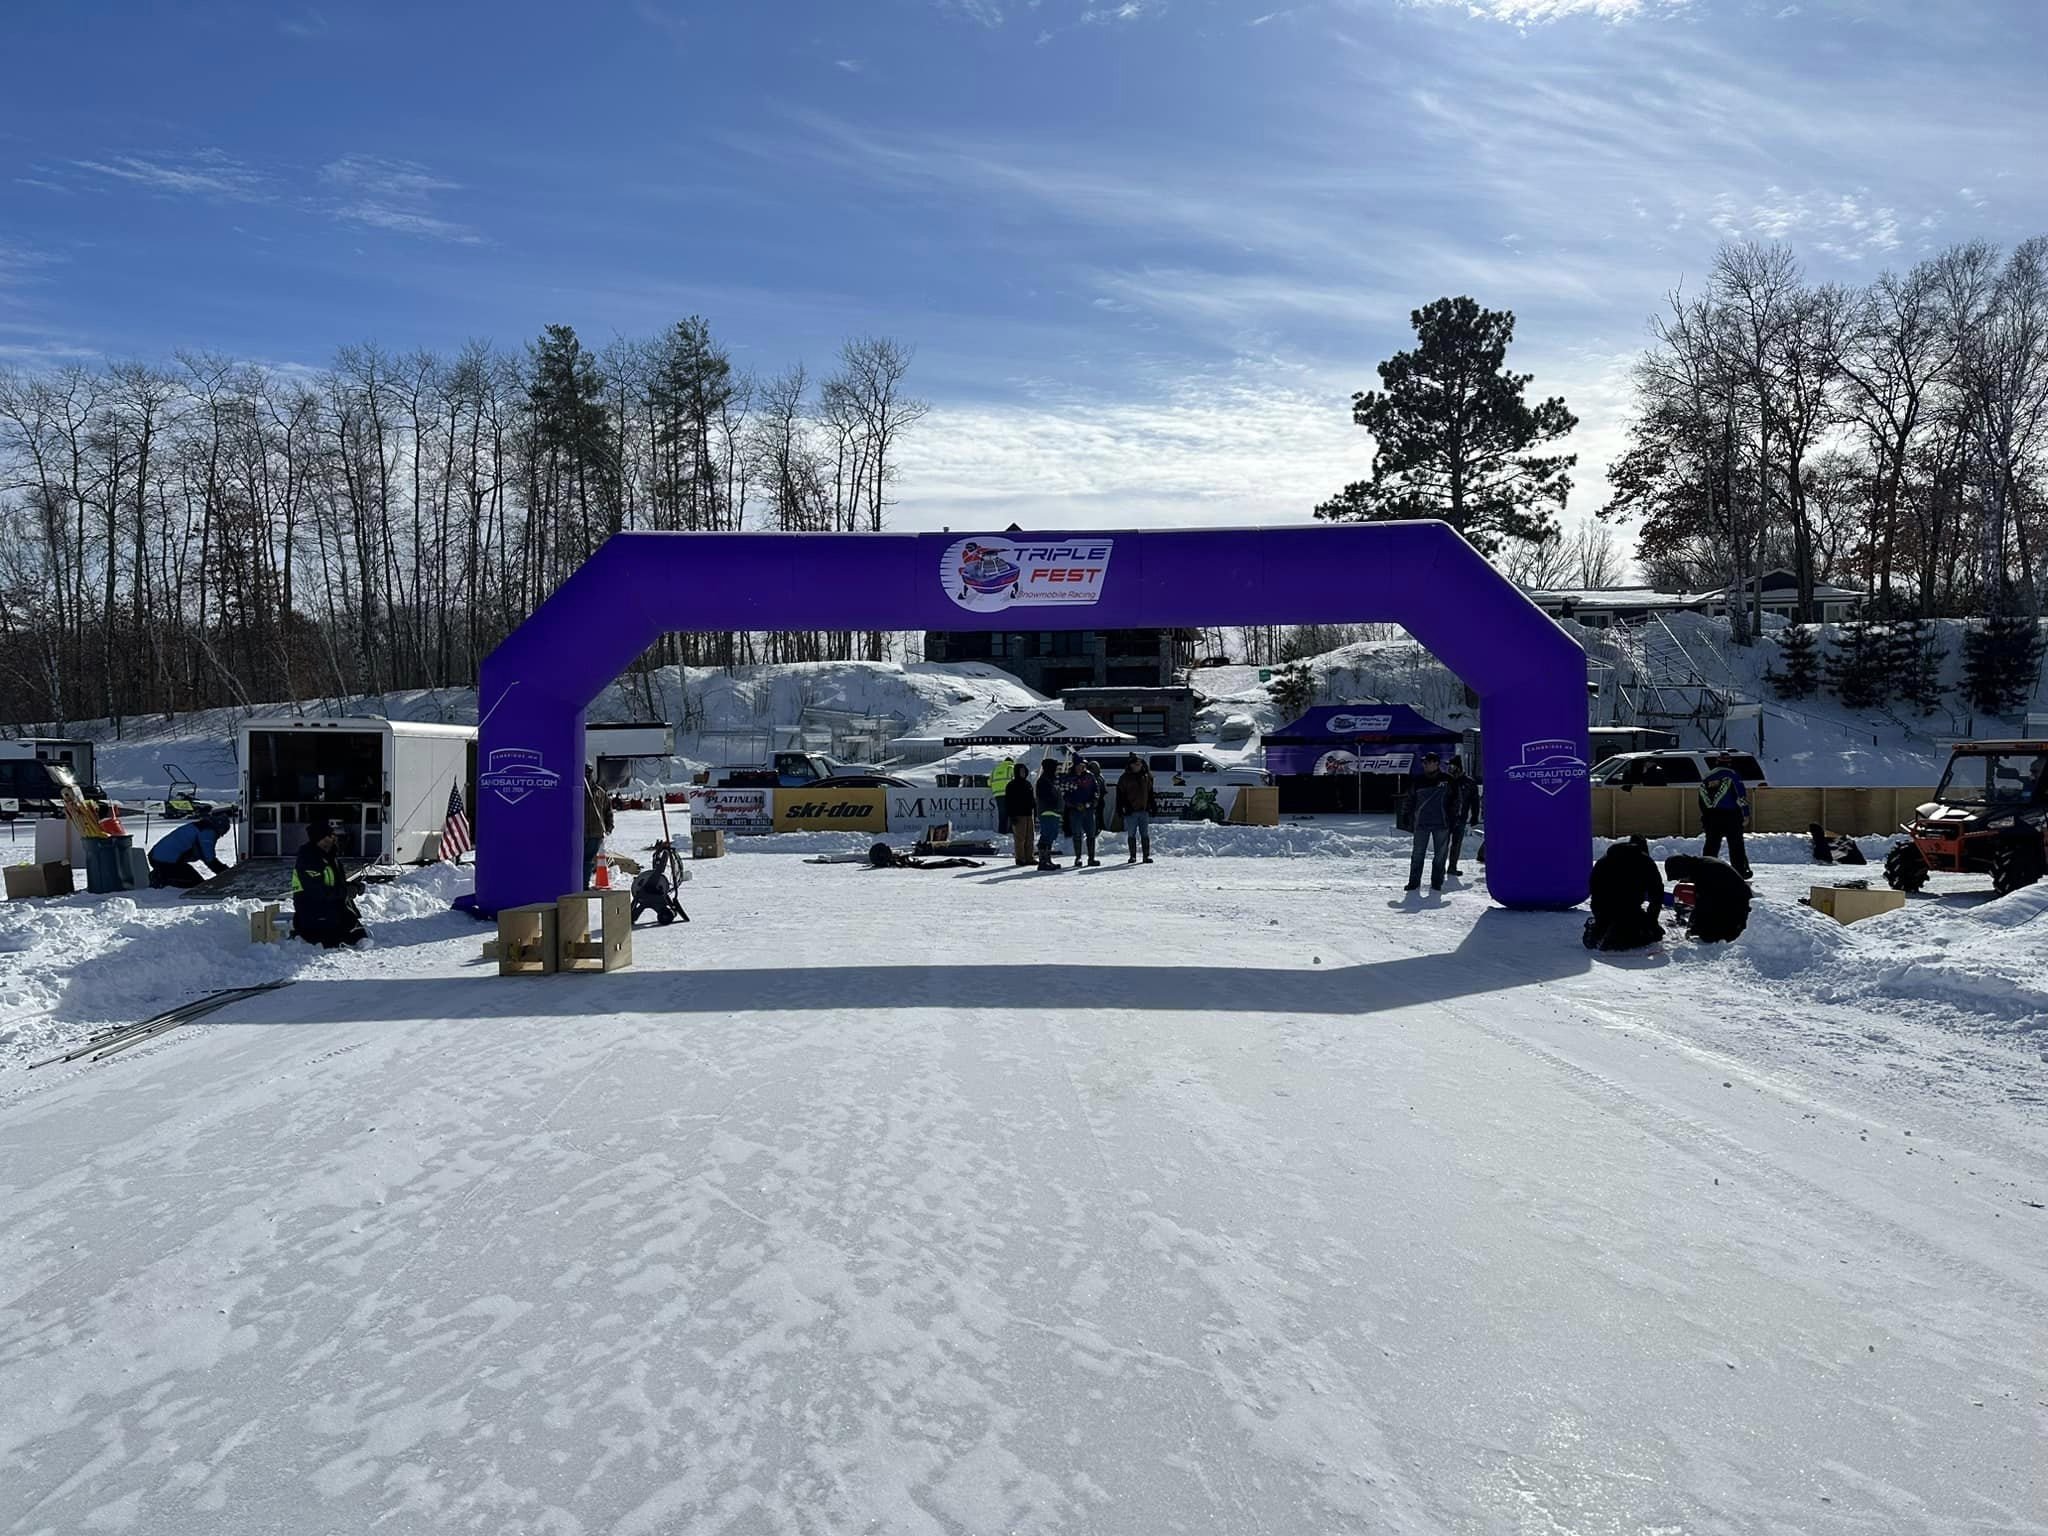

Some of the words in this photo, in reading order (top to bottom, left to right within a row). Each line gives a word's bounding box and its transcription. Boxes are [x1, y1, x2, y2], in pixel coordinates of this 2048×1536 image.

[1014, 547, 1107, 562] TRIPLE
[1030, 568, 1103, 584] FEST
[1067, 589, 1097, 600] Racing
[1355, 759, 1411, 769] TRIPLE
[706, 795, 764, 804] PLATINUM
[929, 797, 996, 811] MICHELS
